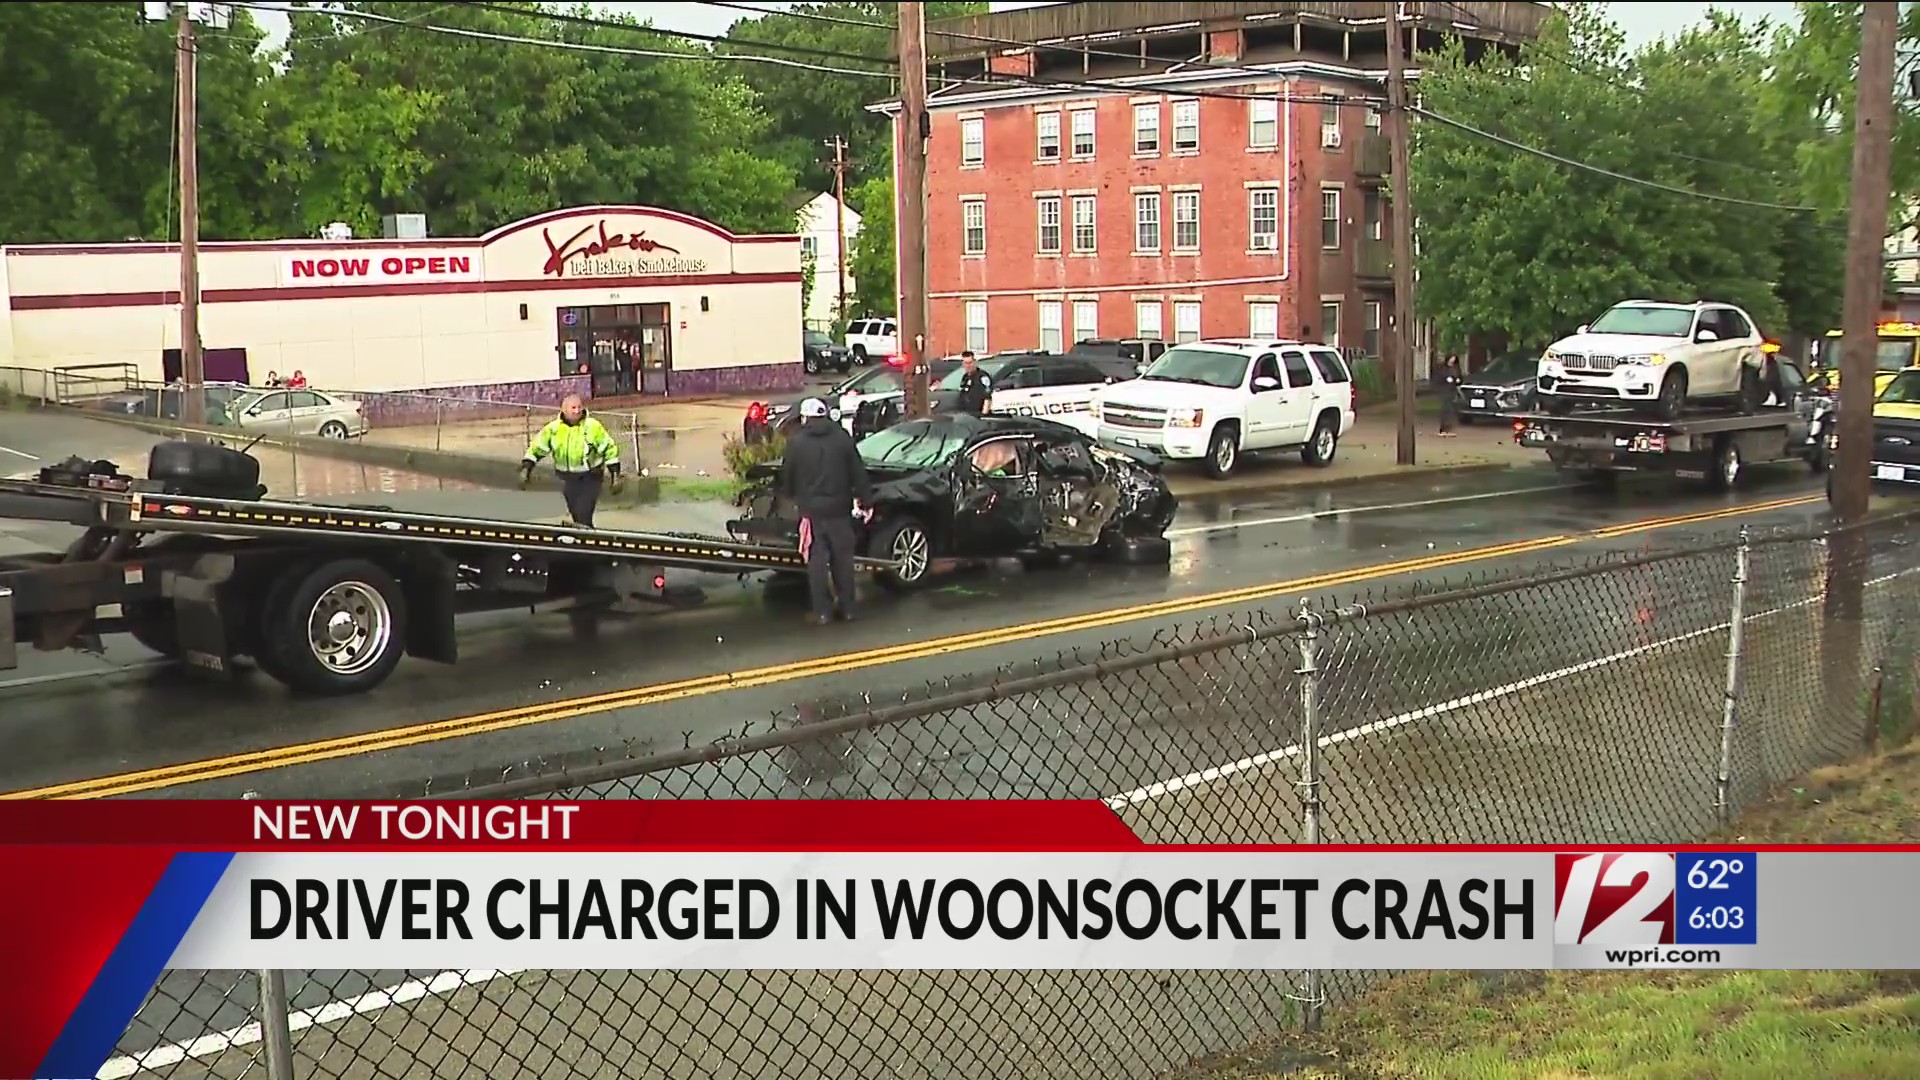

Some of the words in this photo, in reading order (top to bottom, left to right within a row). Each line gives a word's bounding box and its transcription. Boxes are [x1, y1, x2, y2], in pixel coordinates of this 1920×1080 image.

[292, 259, 370, 277] NOW
[381, 257, 470, 275] OPEN
[571, 260, 594, 276] Deli
[595, 258, 637, 278] Bakery
[638, 256, 707, 274] Smokehouse
[1006, 402, 1073, 417] POLICE
